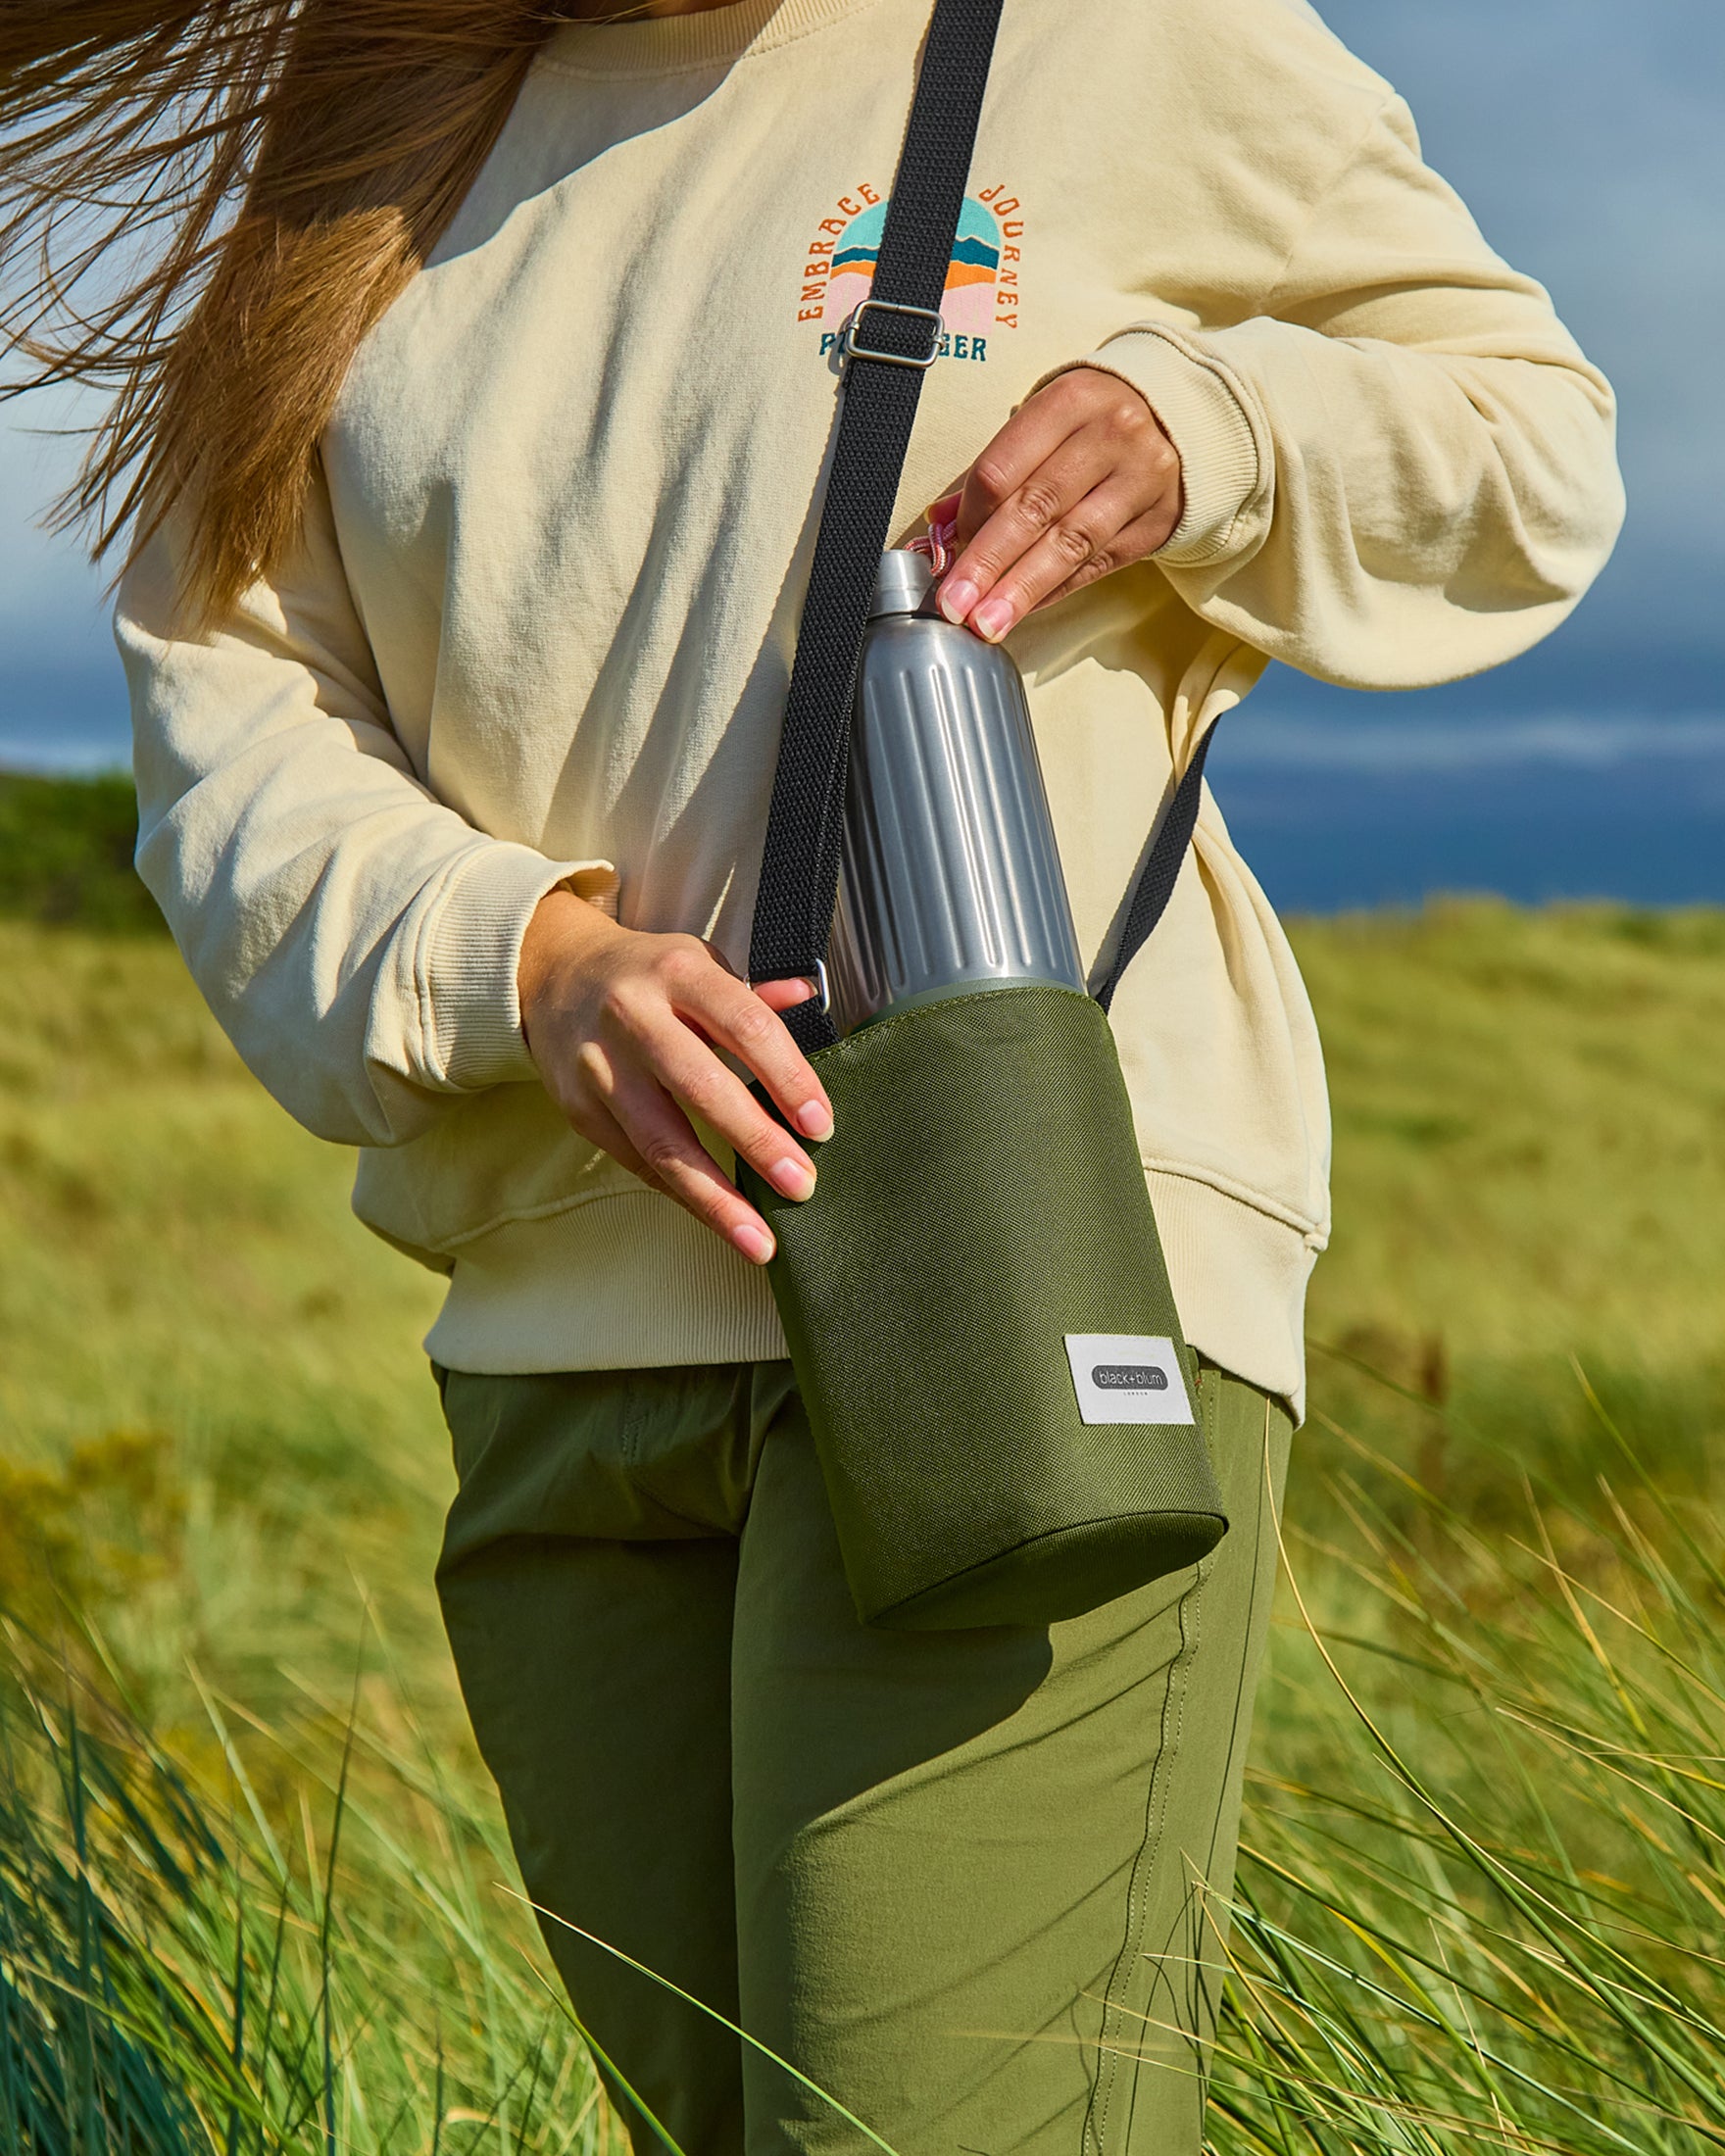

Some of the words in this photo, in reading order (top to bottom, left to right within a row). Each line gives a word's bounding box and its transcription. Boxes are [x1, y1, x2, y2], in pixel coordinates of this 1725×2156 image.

[797, 183, 880, 322] EMBRACE
[978, 184, 1024, 329] JOURNEY
[1099, 1370, 1163, 1385] black+blum
